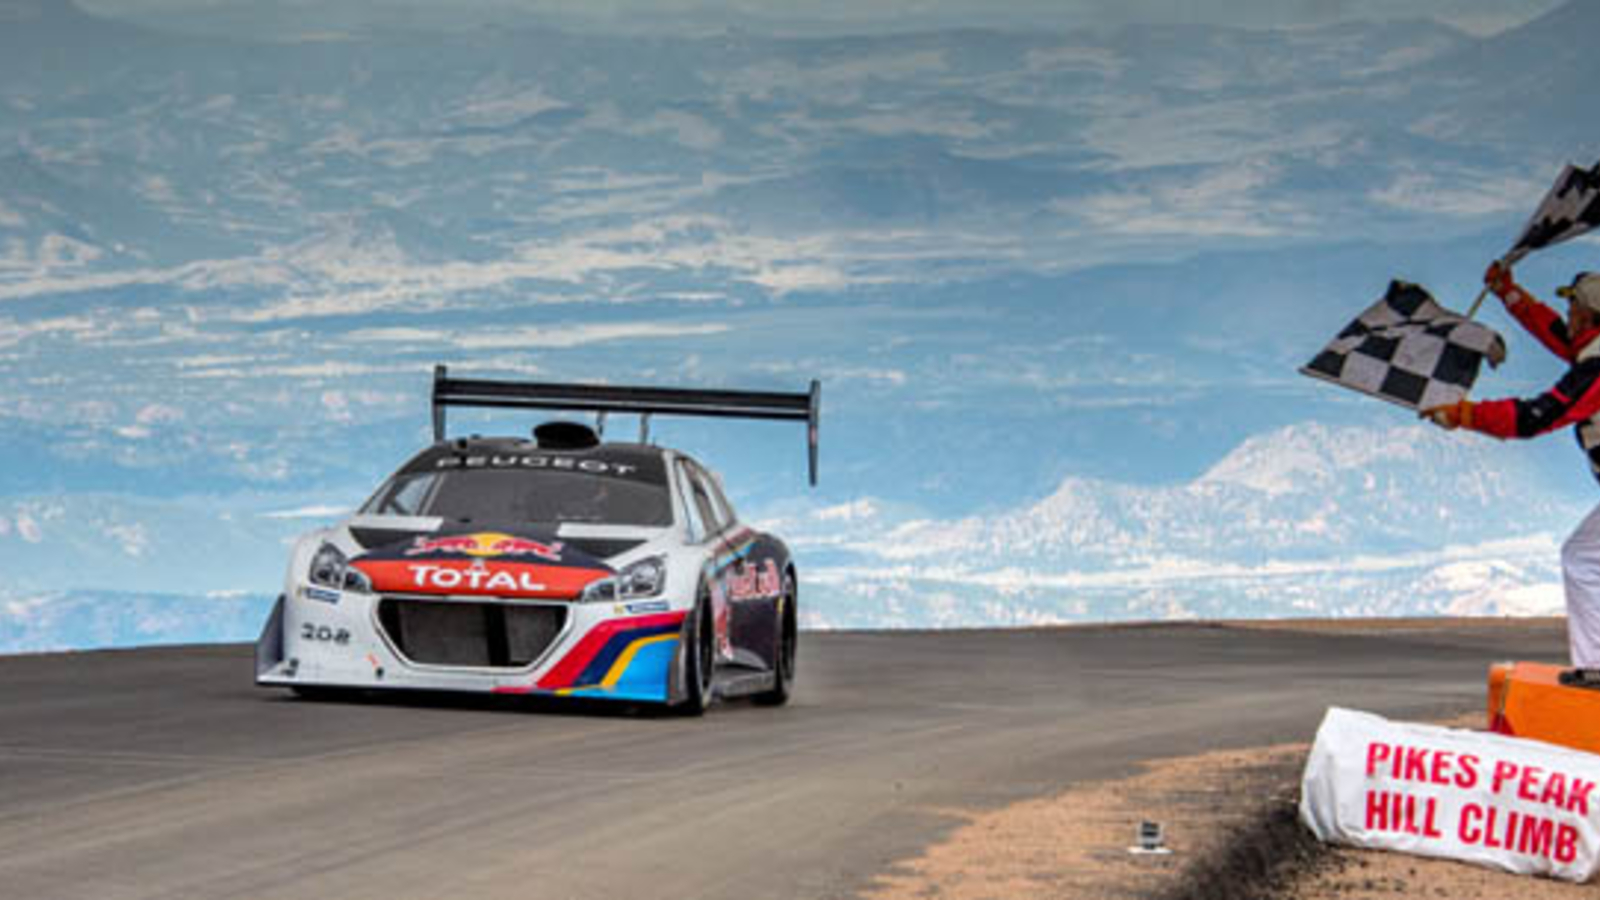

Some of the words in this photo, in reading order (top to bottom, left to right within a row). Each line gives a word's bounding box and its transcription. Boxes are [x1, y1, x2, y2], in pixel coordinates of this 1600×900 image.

[436, 456, 637, 474] PEUGEOT
[408, 564, 546, 592] TOTAL
[301, 622, 350, 645] 208
[1366, 742, 1480, 789] PIKES
[1492, 761, 1596, 816] PEAK
[1365, 790, 1442, 839] HILL
[1458, 803, 1579, 865] CLIMB
